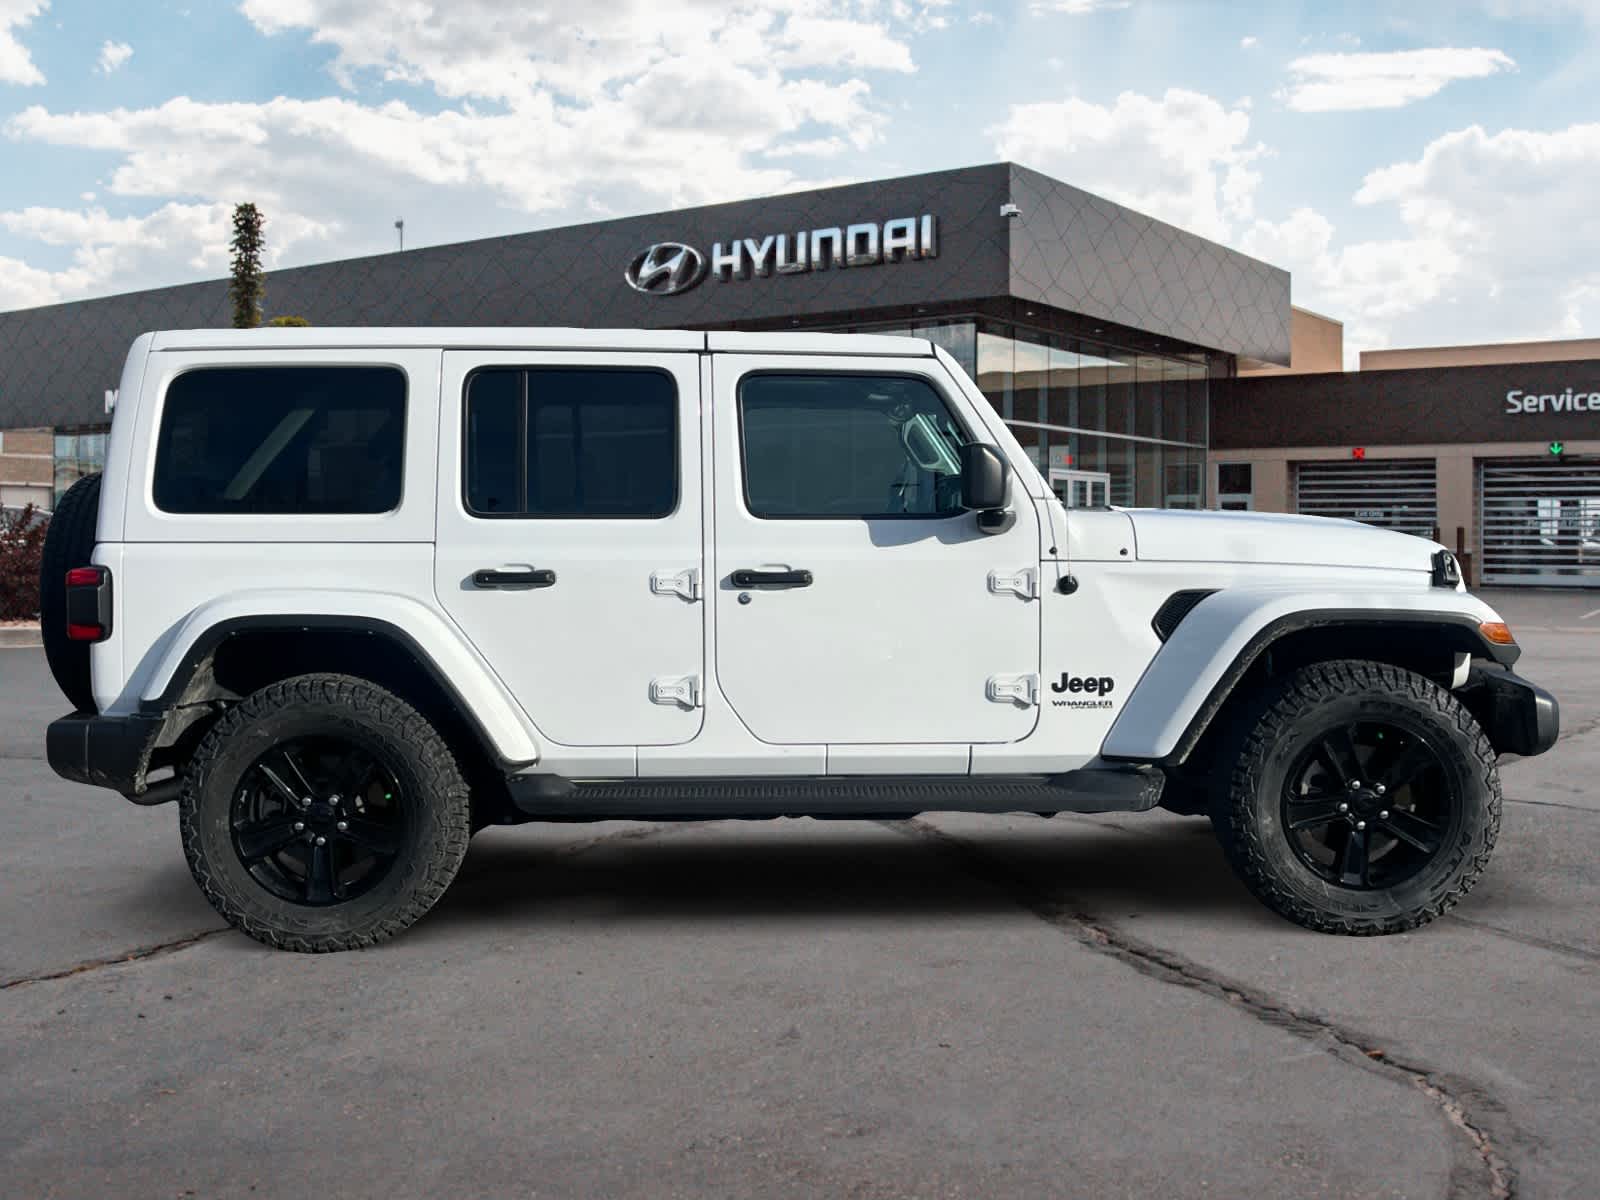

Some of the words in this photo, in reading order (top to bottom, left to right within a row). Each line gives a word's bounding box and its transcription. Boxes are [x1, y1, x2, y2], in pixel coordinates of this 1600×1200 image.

[711, 213, 935, 281] HYUNDAI
[1505, 387, 1600, 414] Service
[1051, 672, 1114, 697] Jeep
